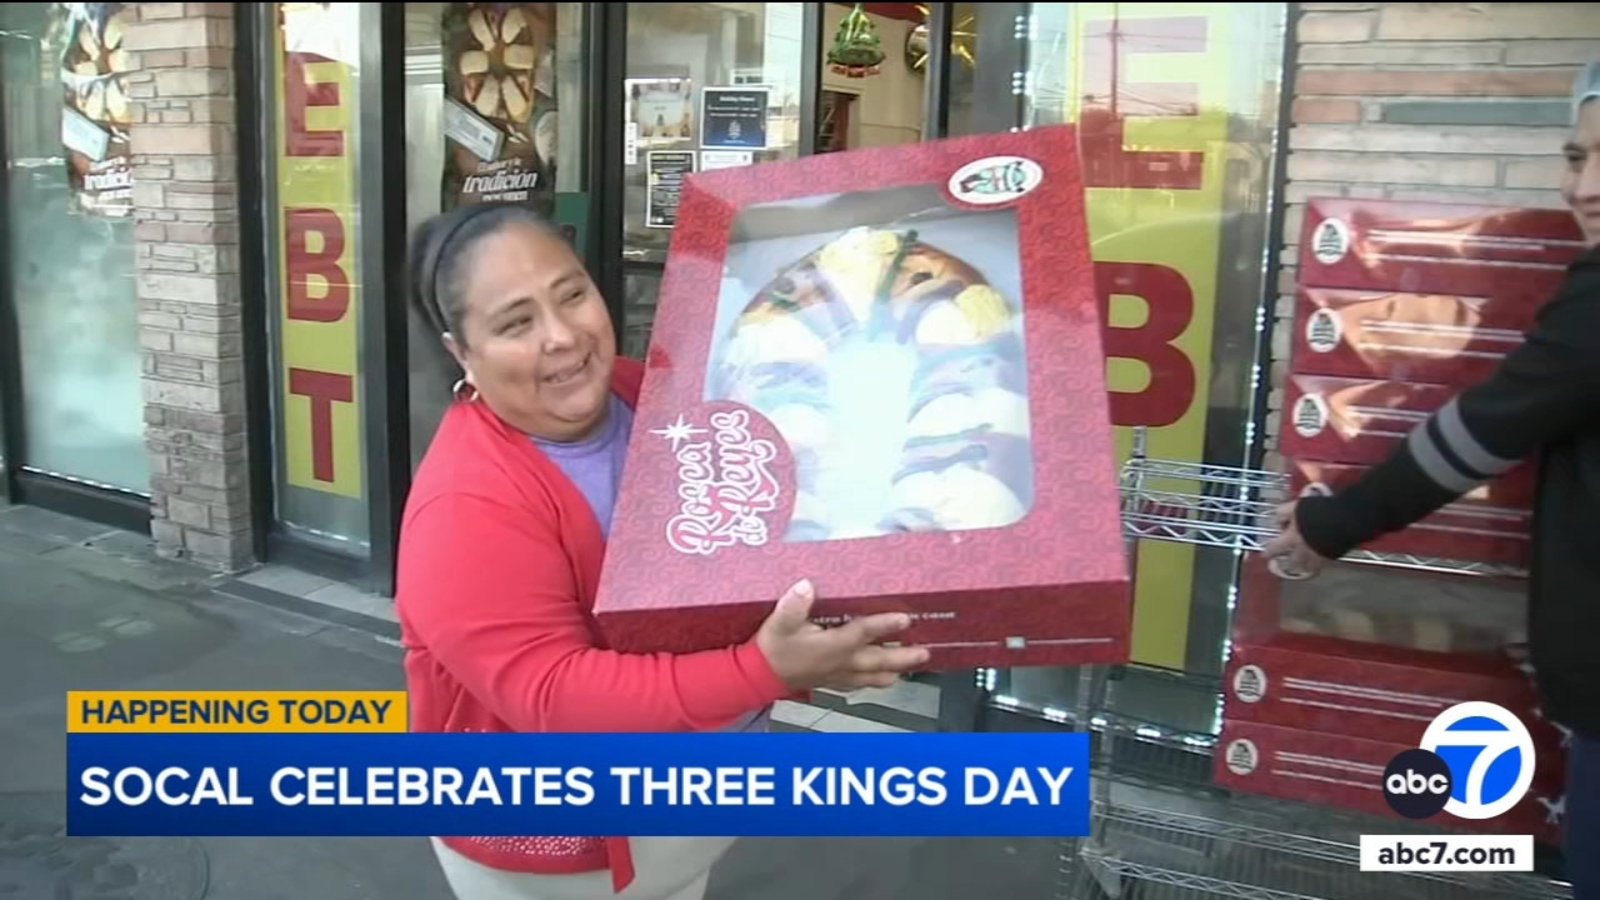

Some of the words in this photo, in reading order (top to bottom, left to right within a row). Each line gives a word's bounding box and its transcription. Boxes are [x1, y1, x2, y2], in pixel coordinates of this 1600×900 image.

[284, 52, 353, 483] EBT
[666, 441, 737, 554] Rosca
[706, 409, 780, 518] Reyes
